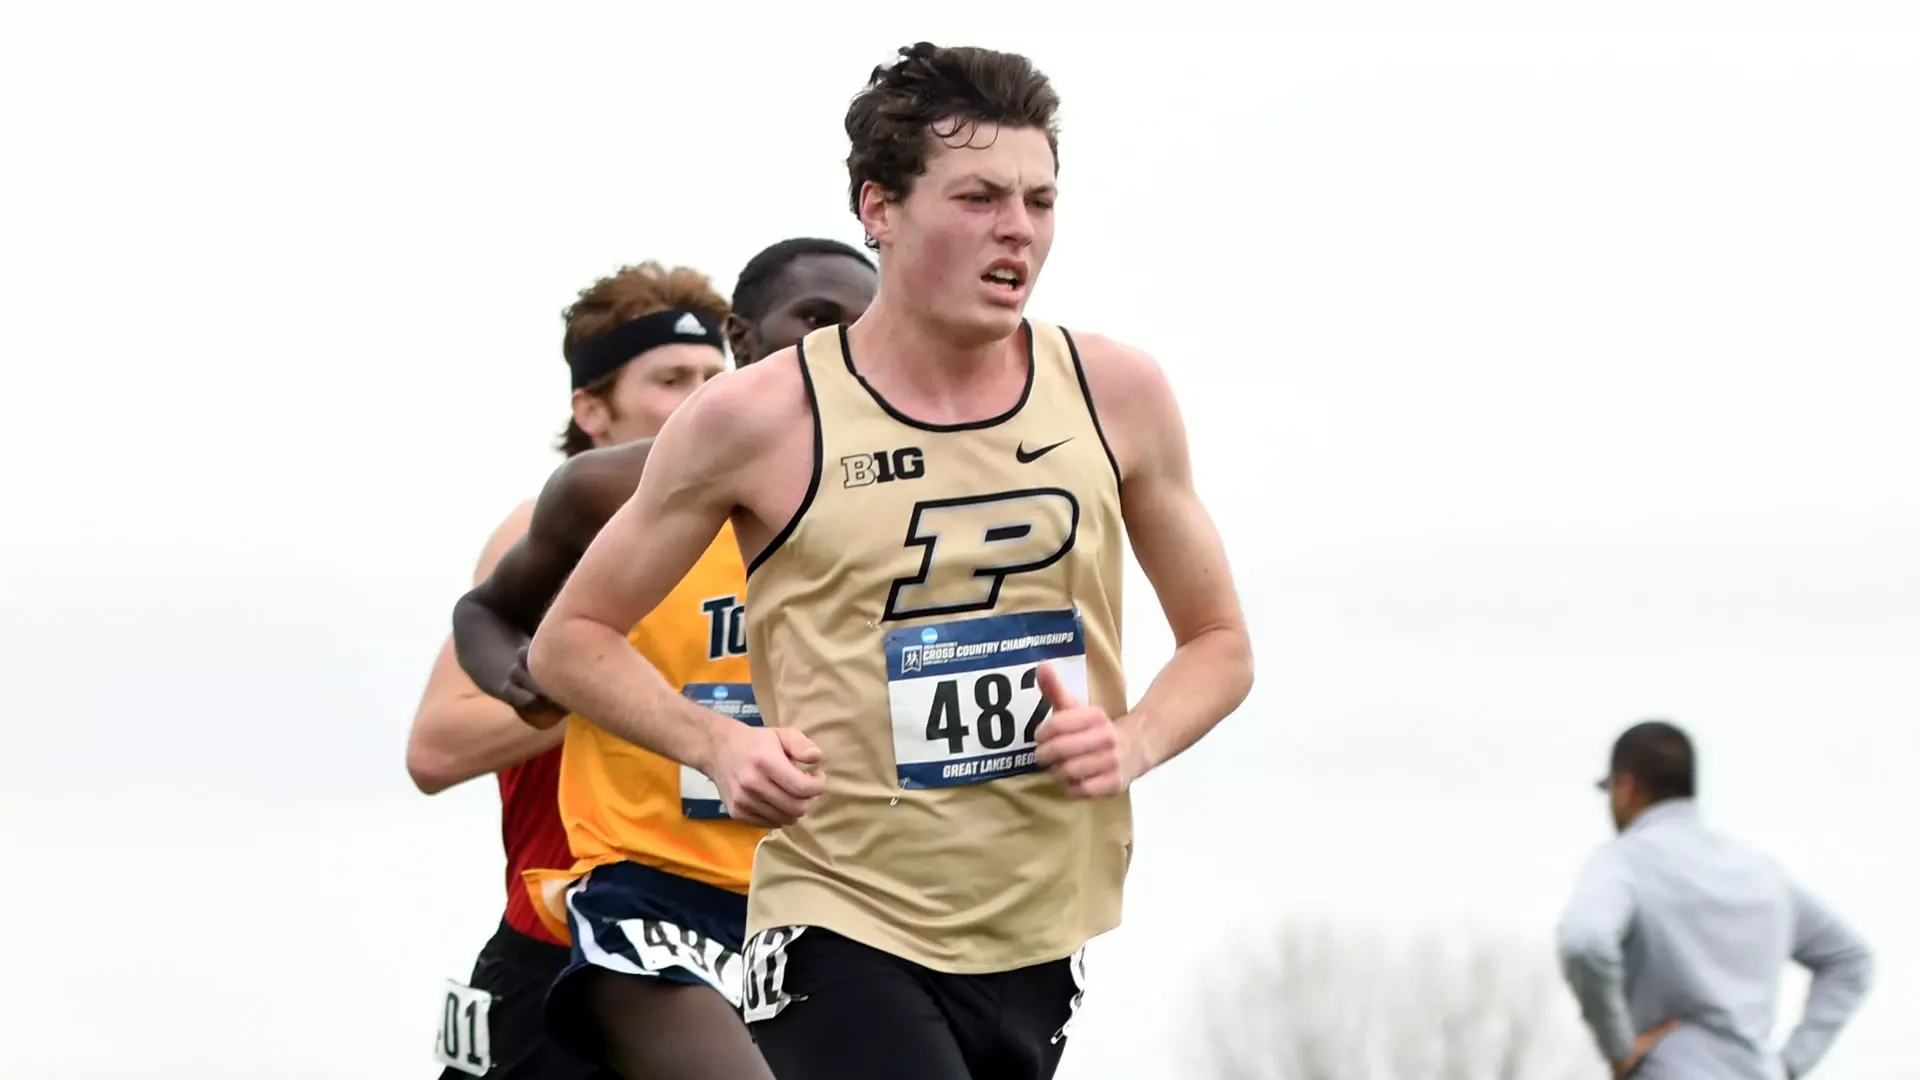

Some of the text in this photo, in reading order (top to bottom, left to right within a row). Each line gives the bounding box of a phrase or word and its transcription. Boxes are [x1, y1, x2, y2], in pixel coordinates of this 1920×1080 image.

[882, 487, 1080, 621] P
[923, 645, 955, 662] CROSS
[955, 641, 1000, 658] COUNTRY
[1000, 631, 1075, 652] CHAMPIONSHIPS
[925, 667, 1054, 755] 482
[942, 761, 980, 779] GREAT
[980, 755, 1013, 774] LAKES
[438, 991, 483, 1068] 01
